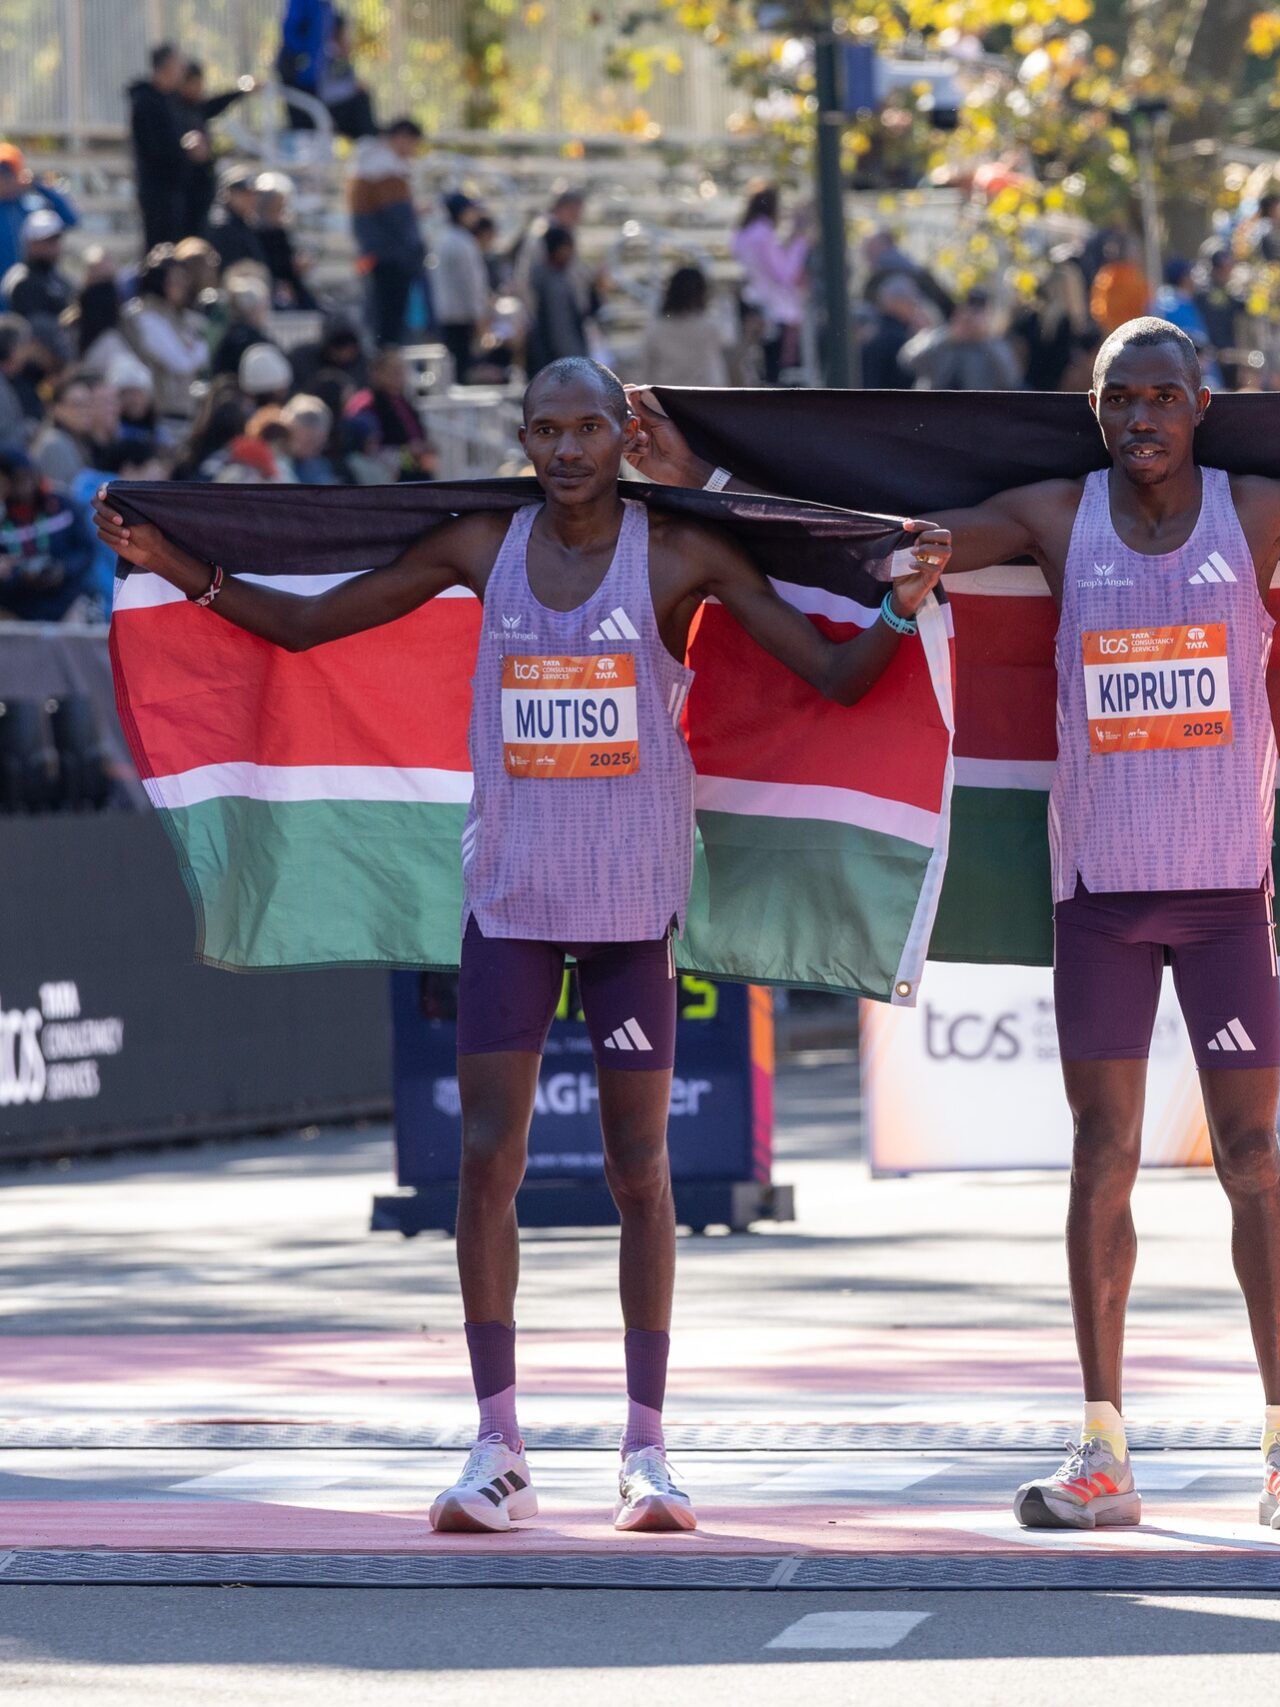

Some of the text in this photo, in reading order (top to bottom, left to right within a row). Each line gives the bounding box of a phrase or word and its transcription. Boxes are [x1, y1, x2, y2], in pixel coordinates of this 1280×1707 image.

[1077, 578, 1134, 589] Tirop's Angels
[1100, 635, 1128, 654] tcs
[1131, 638, 1174, 646] CONSULTANCY
[1132, 645, 1159, 653] SERVICES
[1185, 641, 1208, 649] TATA
[514, 660, 539, 679] tcs
[1099, 667, 1216, 713] KIPRUTO
[516, 698, 619, 738] MUTISO
[1183, 722, 1223, 736] 2025
[589, 752, 631, 766] 2025
[923, 1001, 1022, 1062] tcs
[0, 1006, 47, 1105] cs
